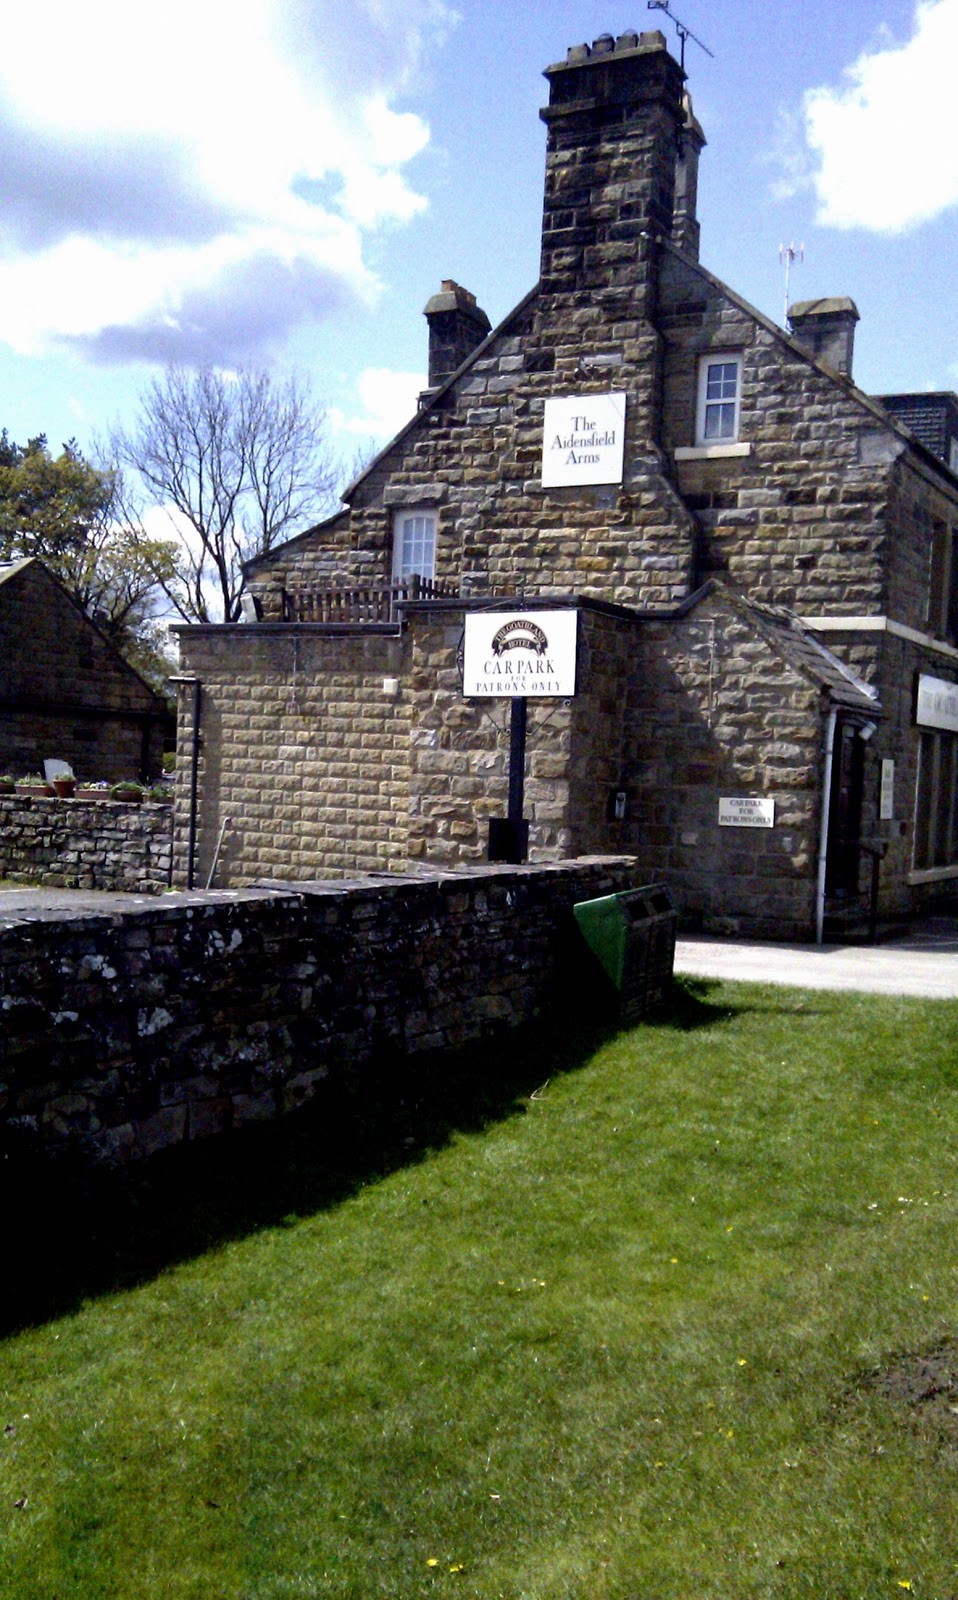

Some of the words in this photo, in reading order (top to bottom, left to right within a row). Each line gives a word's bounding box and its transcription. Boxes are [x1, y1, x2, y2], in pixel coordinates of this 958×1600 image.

[571, 416, 596, 431] The
[551, 430, 615, 449] Aidensfield
[566, 449, 600, 465] Arms
[495, 628, 507, 641] THE
[508, 640, 530, 649] HOTEL
[484, 661, 512, 674] CAR
[517, 660, 554, 674] PARK
[476, 682, 526, 692] PATRONS
[531, 682, 561, 691] ONLY
[739, 807, 754, 815] FOR
[752, 816, 771, 824] ONLY
